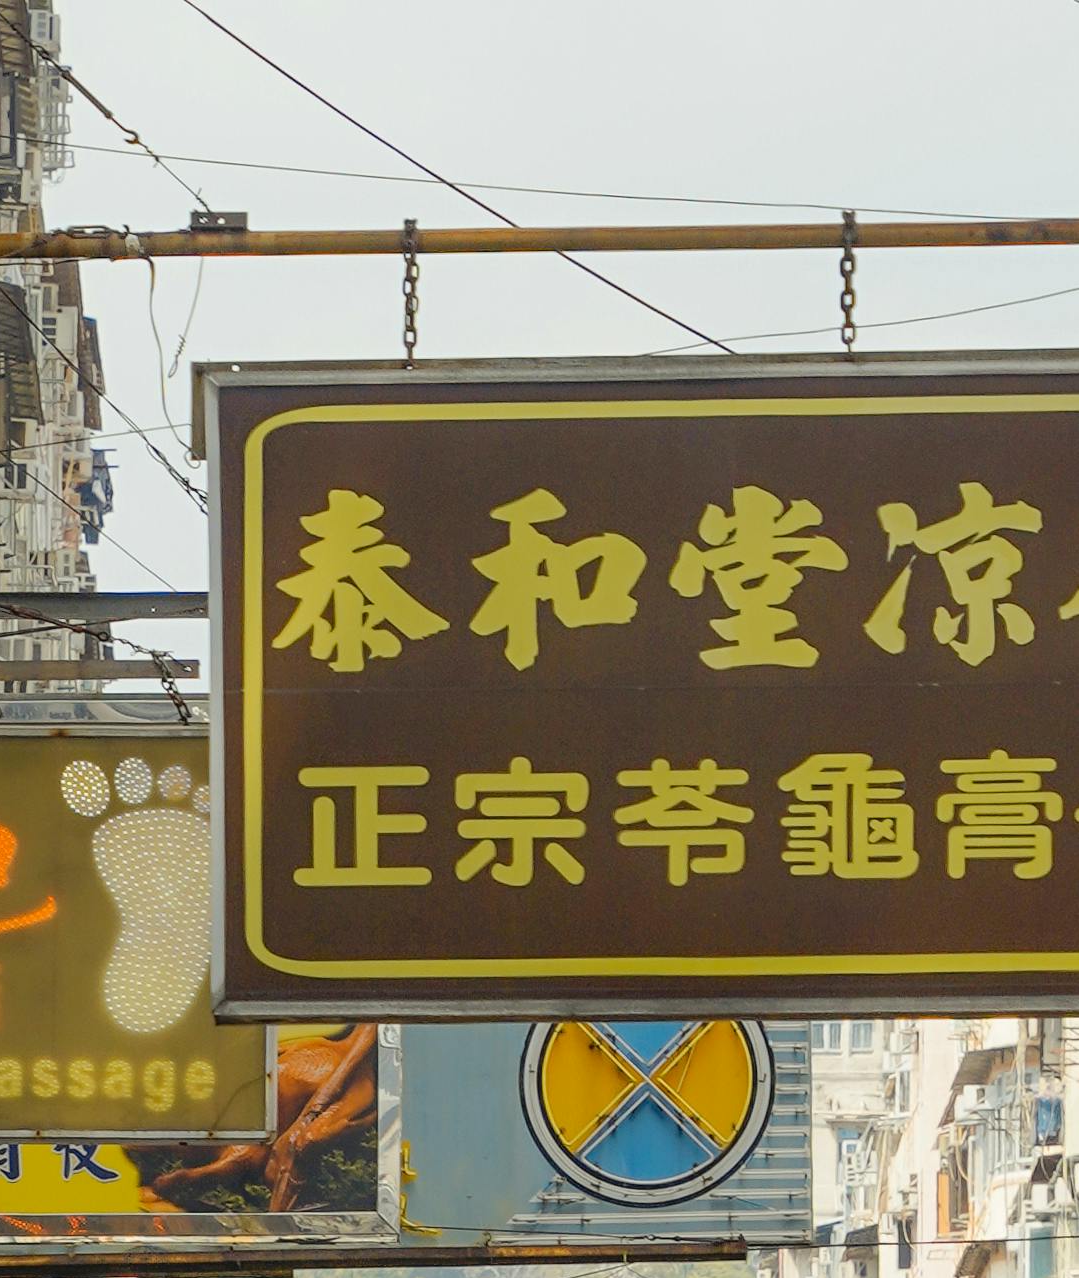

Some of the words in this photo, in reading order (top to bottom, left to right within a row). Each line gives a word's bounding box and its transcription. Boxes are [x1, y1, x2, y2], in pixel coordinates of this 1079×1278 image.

[272, 482, 1079, 672] 泰和堂凉
[294, 750, 1079, 888] 正宗苓龜膏
